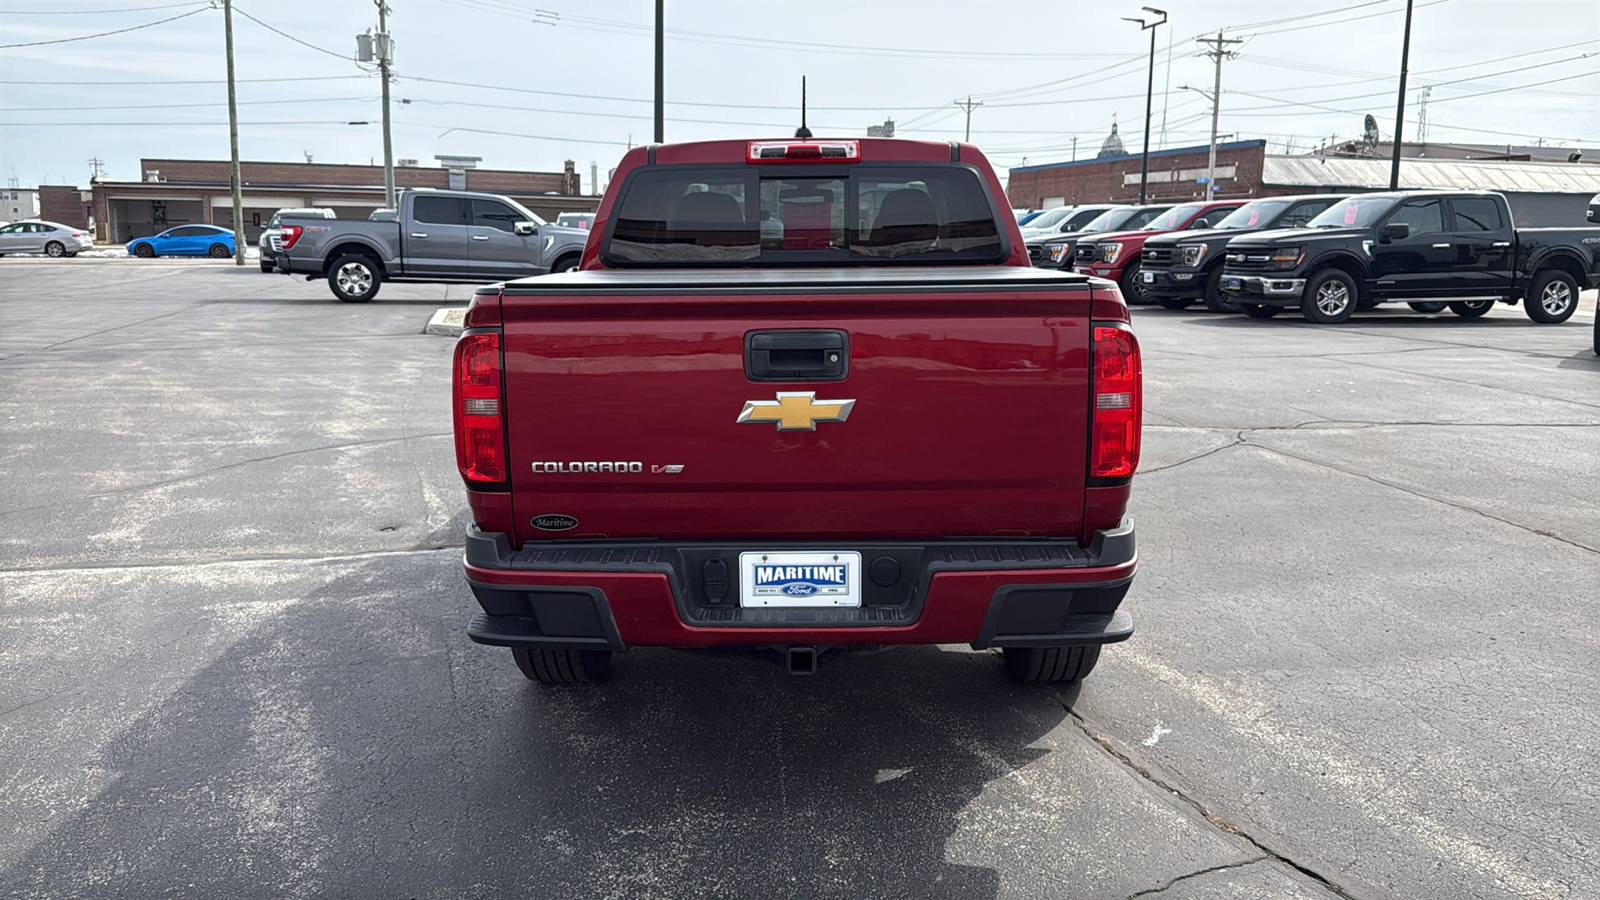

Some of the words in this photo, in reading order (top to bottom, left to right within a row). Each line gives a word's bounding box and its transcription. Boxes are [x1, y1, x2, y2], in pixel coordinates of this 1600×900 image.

[531, 461, 643, 474] COLORADO
[536, 517, 574, 528] Maritime
[757, 566, 845, 585] MARITIME
[787, 585, 813, 595] Ford
